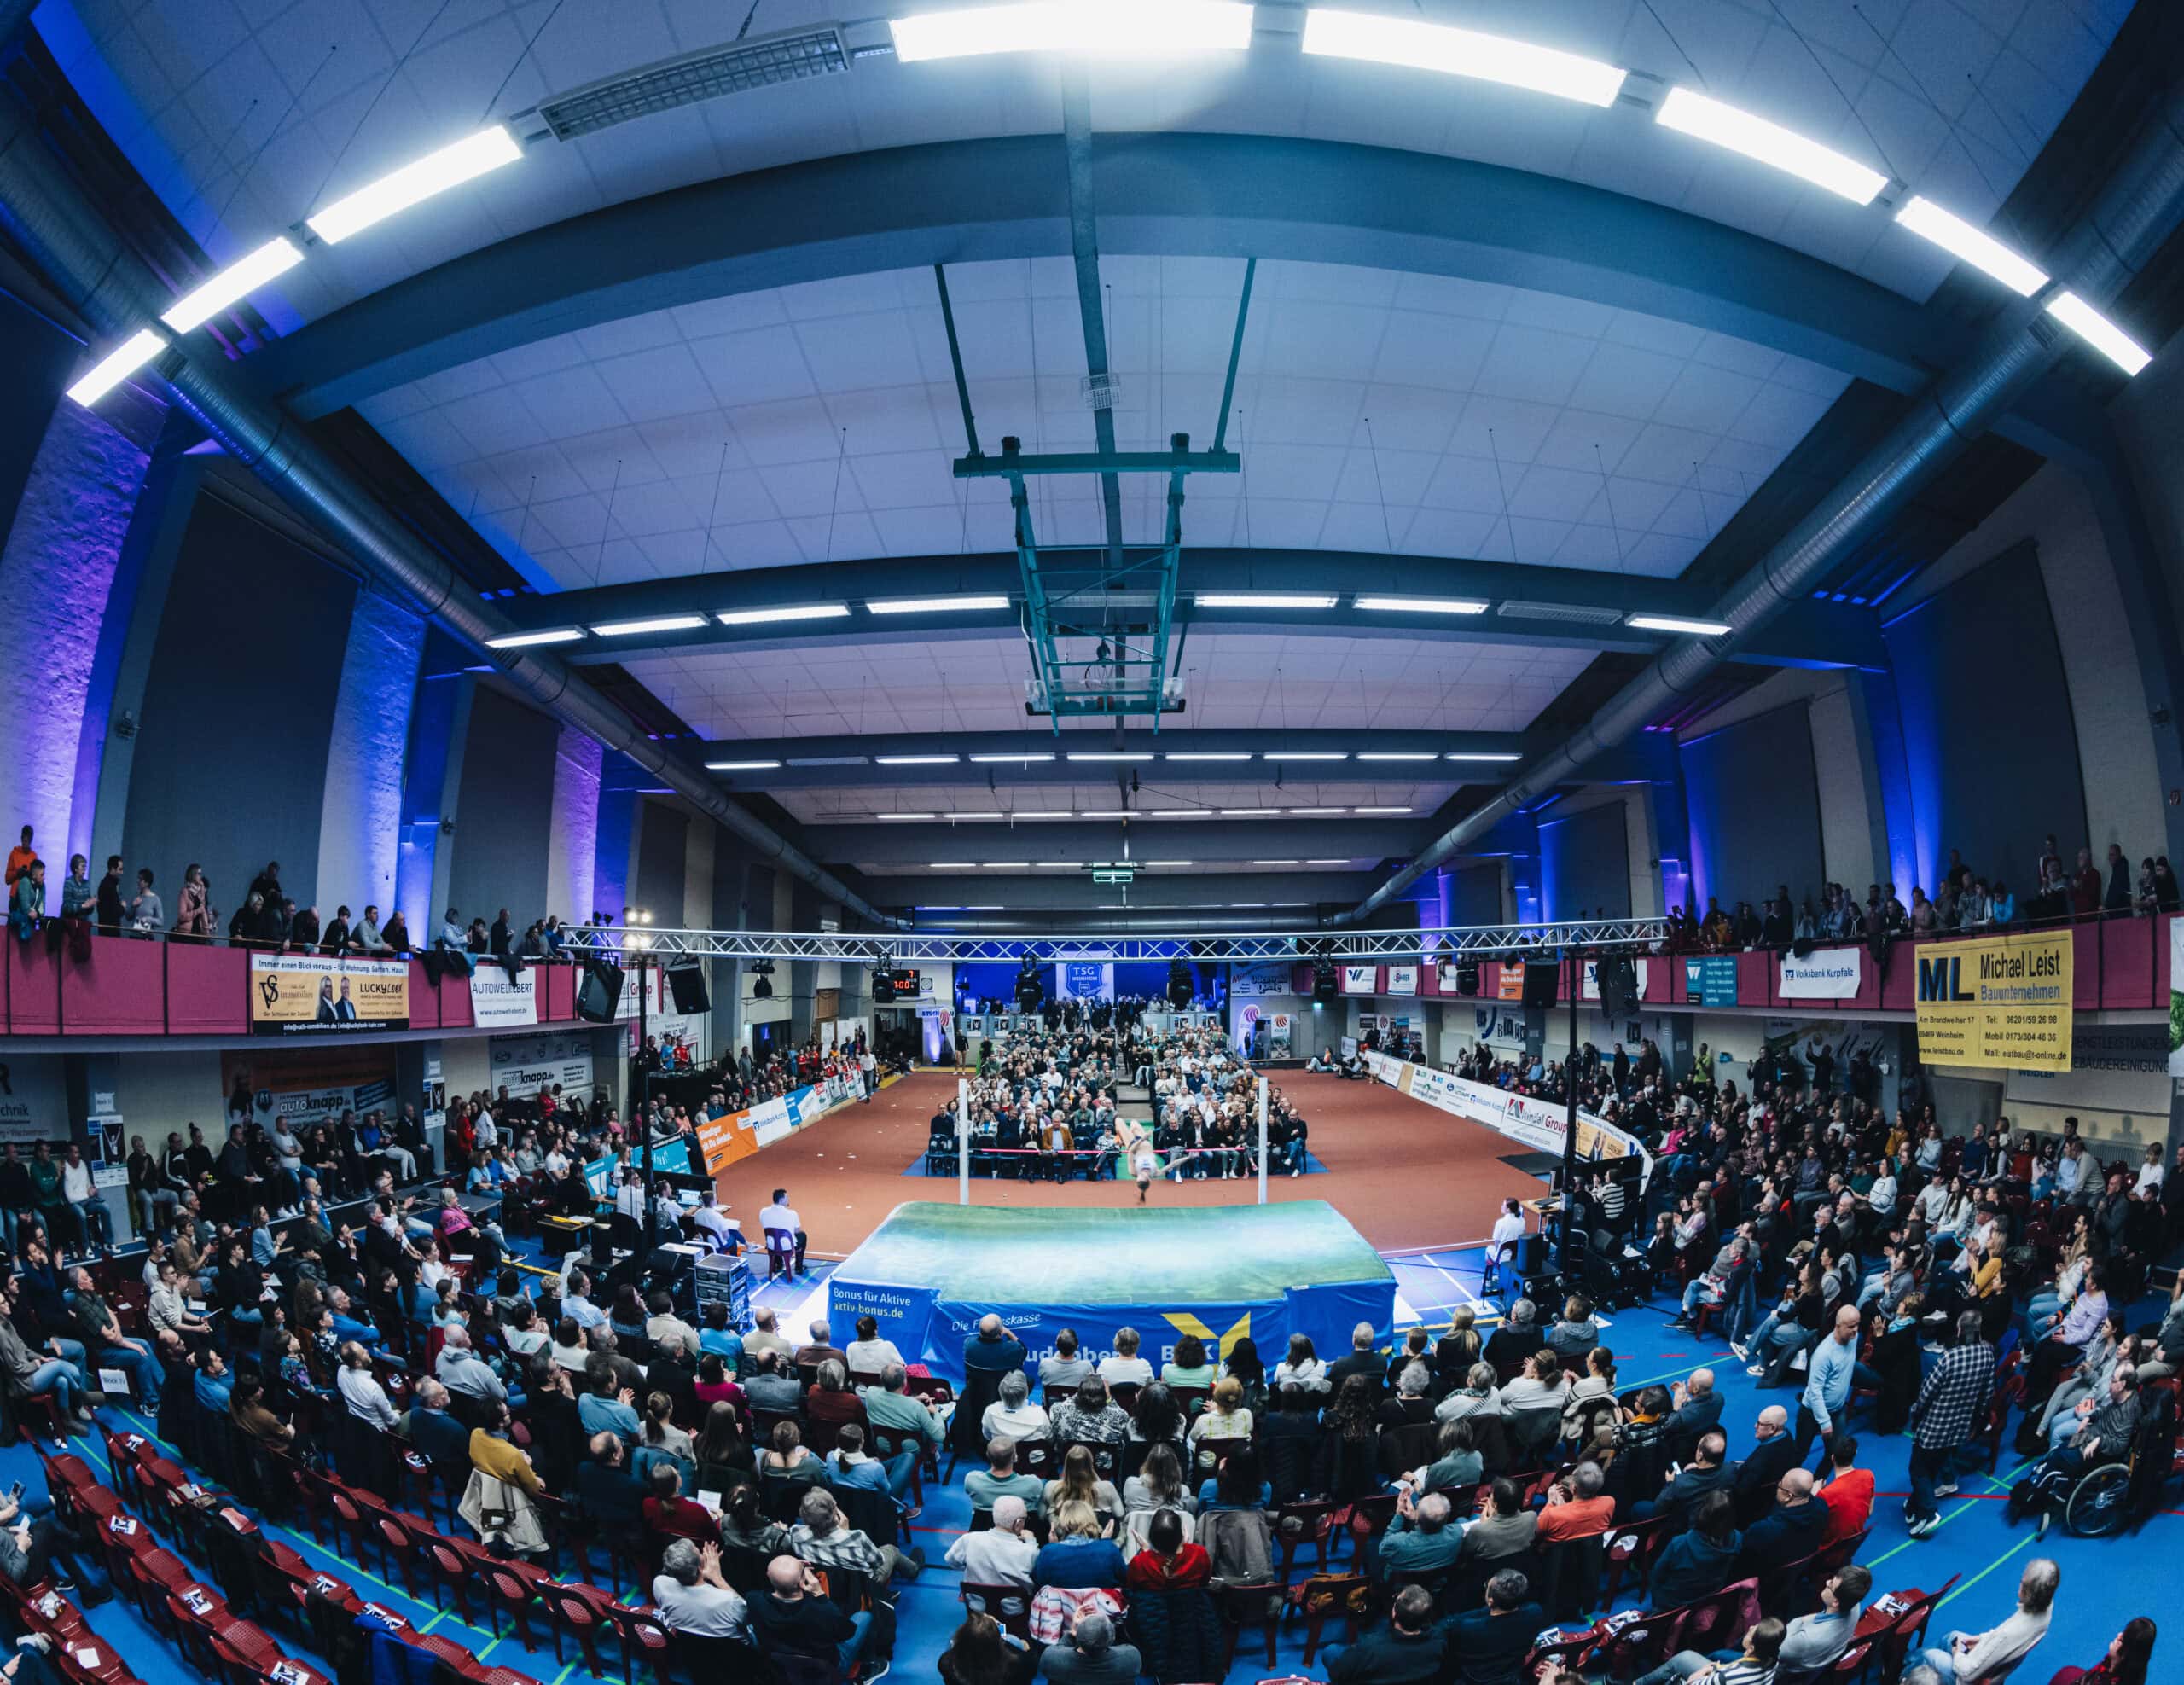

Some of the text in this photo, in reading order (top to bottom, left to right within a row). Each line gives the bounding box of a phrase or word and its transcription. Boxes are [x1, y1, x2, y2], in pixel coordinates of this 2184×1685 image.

[259, 960, 280, 968] Immer
[299, 962, 312, 970] Blick
[1073, 967, 1095, 975] TSG
[1980, 949, 2061, 979] Michael Leist
[1796, 967, 1854, 980] Volksbank Kurpfalz
[1918, 956, 1975, 1002] ML
[630, 982, 653, 1002] Grp
[1981, 983, 2061, 1001] Bauunternehmen
[1930, 1015, 1966, 1024] Brandweiher
[2048, 1015, 2057, 1024] 98
[1937, 1031, 1965, 1039] Weinheim
[2006, 1032, 2036, 1041] 0173/304
[2074, 1037, 2169, 1051] IENSTLEISTUNGEN
[2074, 1056, 2169, 1072] EBÄUDEREINIGUNG
[0, 1101, 29, 1117] chnik
[1545, 1115, 1569, 1140] Group
[834, 1287, 911, 1306] Bonus für Aktive
[951, 1320, 970, 1332] Die
[1161, 1344, 1215, 1362] BK
